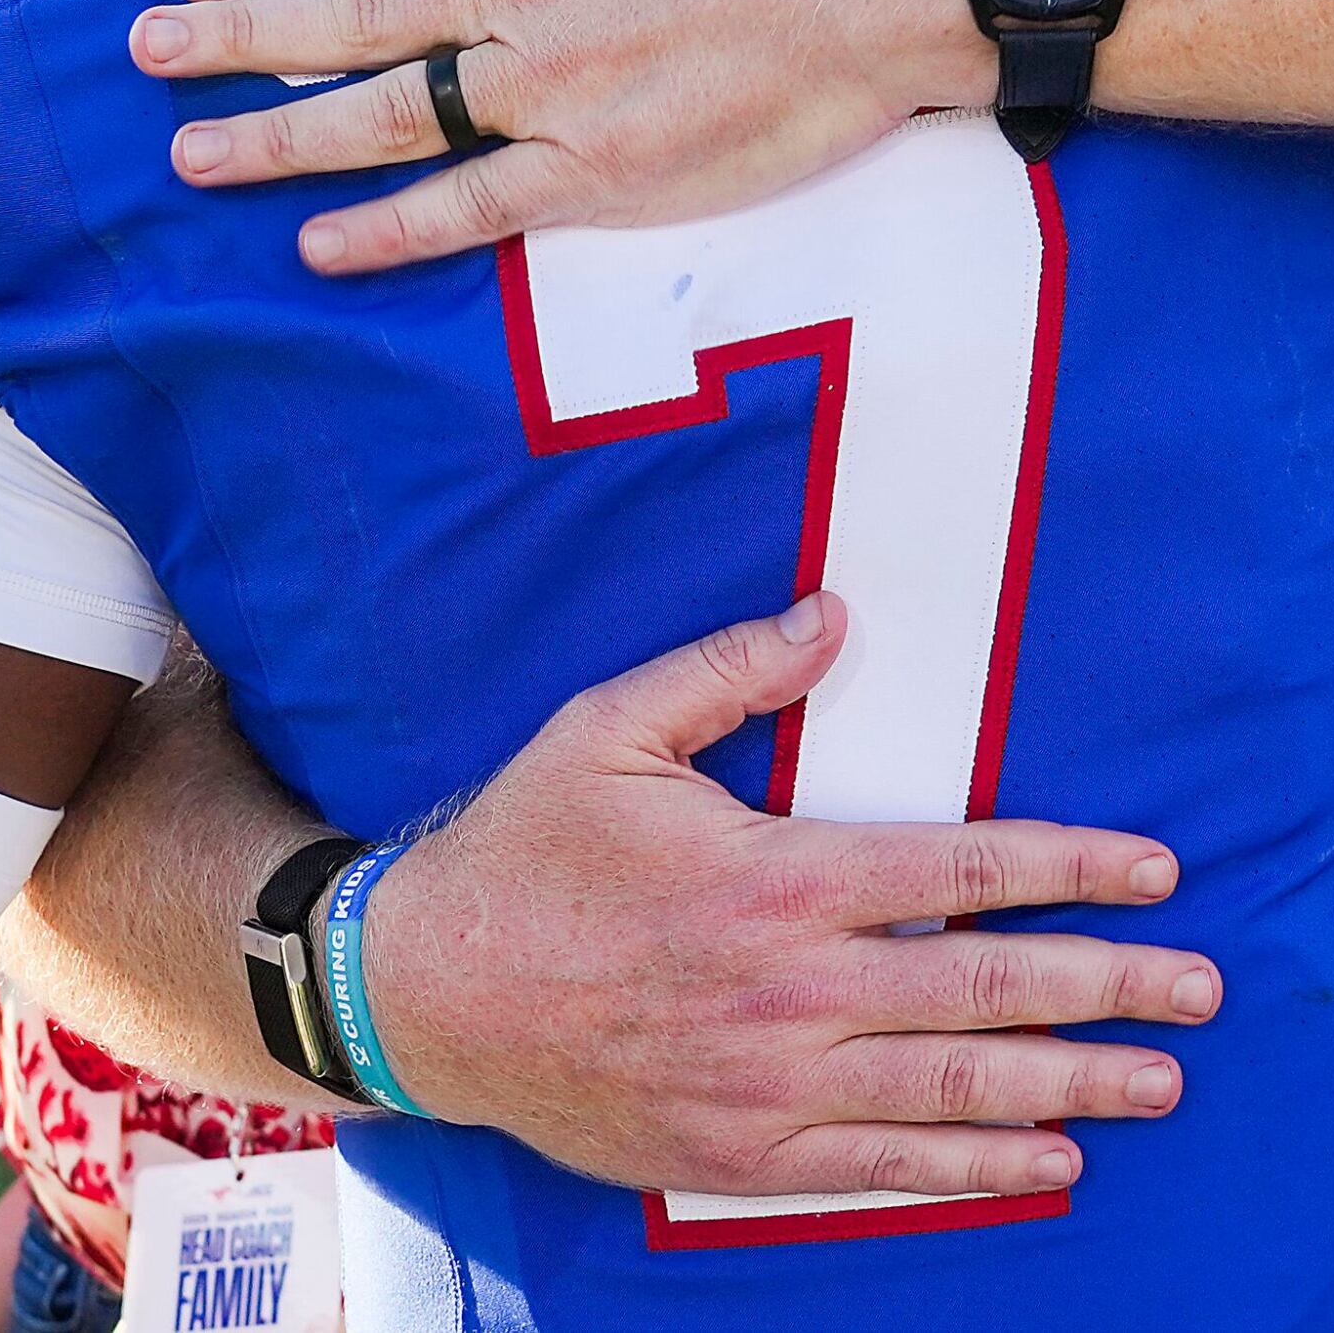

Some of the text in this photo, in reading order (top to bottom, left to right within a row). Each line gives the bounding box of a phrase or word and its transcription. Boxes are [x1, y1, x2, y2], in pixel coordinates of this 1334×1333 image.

[499, 104, 1069, 1252] 7
[331, 858, 377, 1040] CURING KIDS
[175, 1263, 288, 1332] FAMILY
